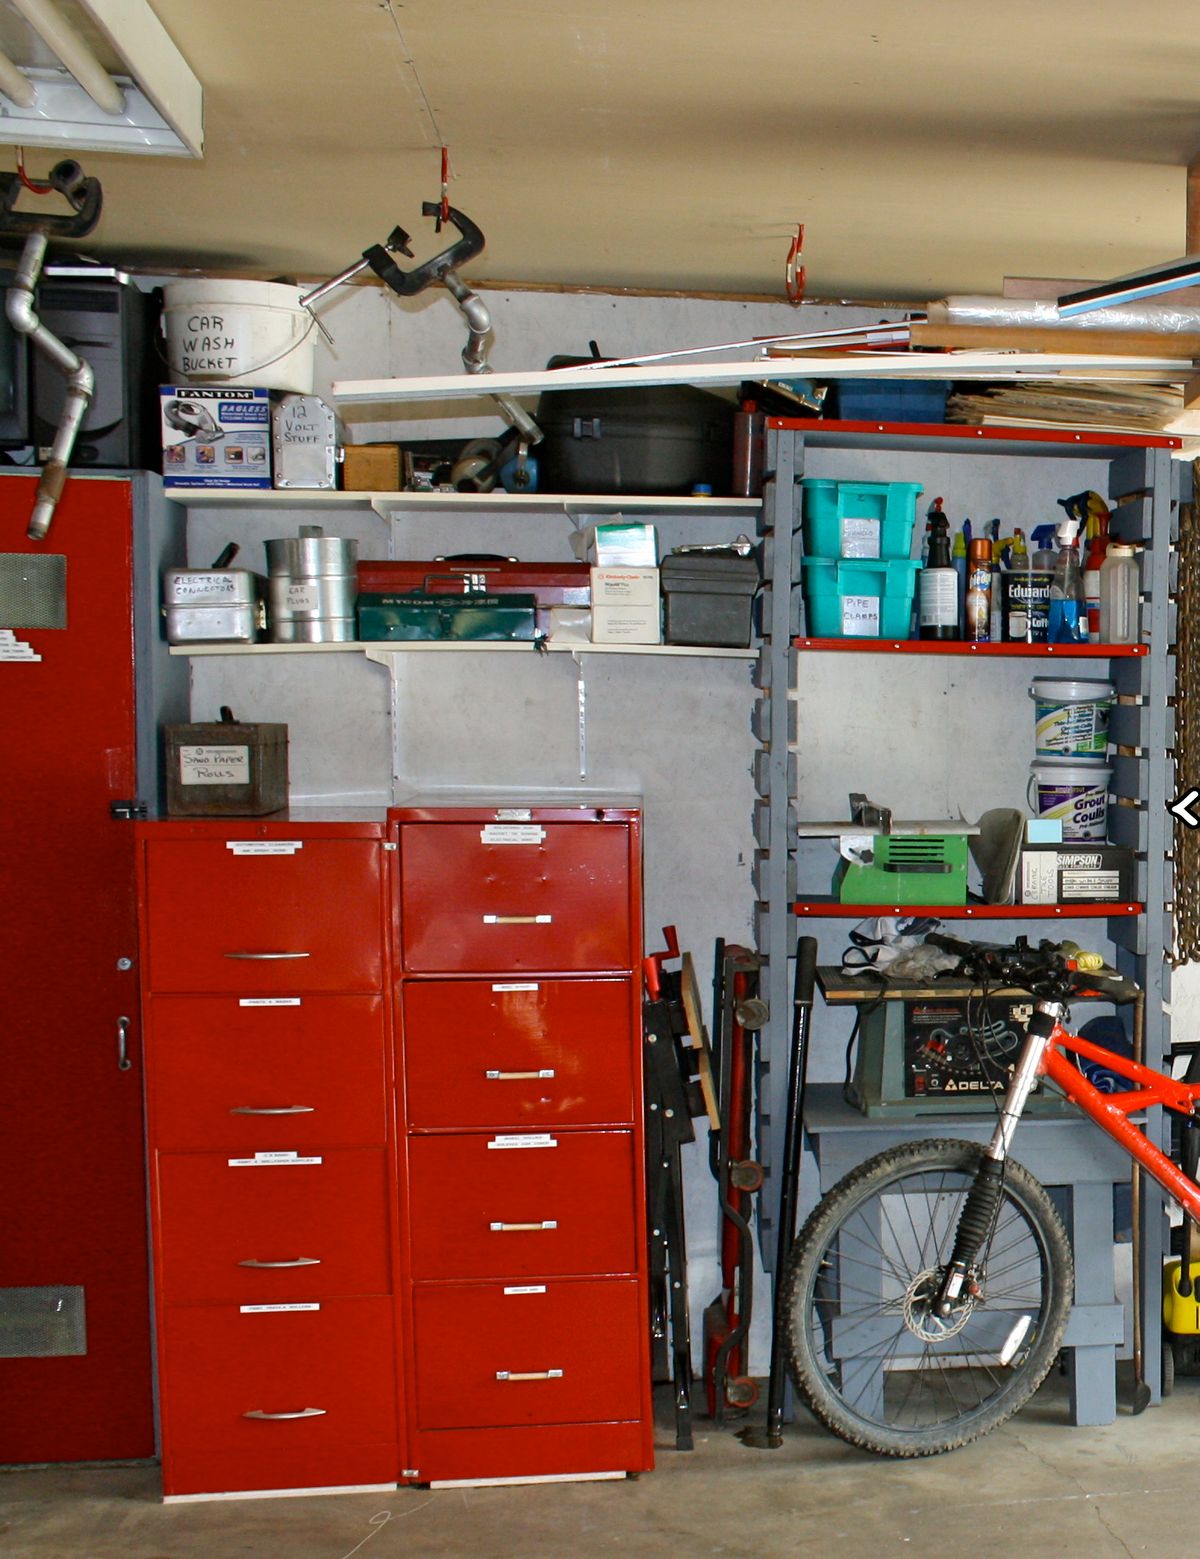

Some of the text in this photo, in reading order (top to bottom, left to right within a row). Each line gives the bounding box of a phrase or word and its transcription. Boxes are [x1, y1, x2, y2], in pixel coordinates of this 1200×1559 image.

[187, 315, 224, 333] CAR
[182, 336, 235, 353] WASH
[182, 356, 238, 372] BUCKET
[180, 390, 252, 399] FANTOM
[220, 404, 268, 413] BAGLESS
[292, 405, 308, 419] 12
[285, 419, 320, 431] VOLT
[284, 431, 321, 443] STUFF
[173, 575, 234, 585] ELECTRICAL
[175, 585, 237, 595] CONNECTORS
[1008, 583, 1050, 599] Edward
[846, 598, 870, 608] PIPE
[843, 611, 878, 621] CLAMPS
[192, 766, 235, 779] ROLLS
[1073, 794, 1106, 811] Grout
[1072, 806, 1106, 824] Coulis
[1057, 855, 1098, 865] SIMPSON
[958, 1080, 1005, 1091] DELTA
